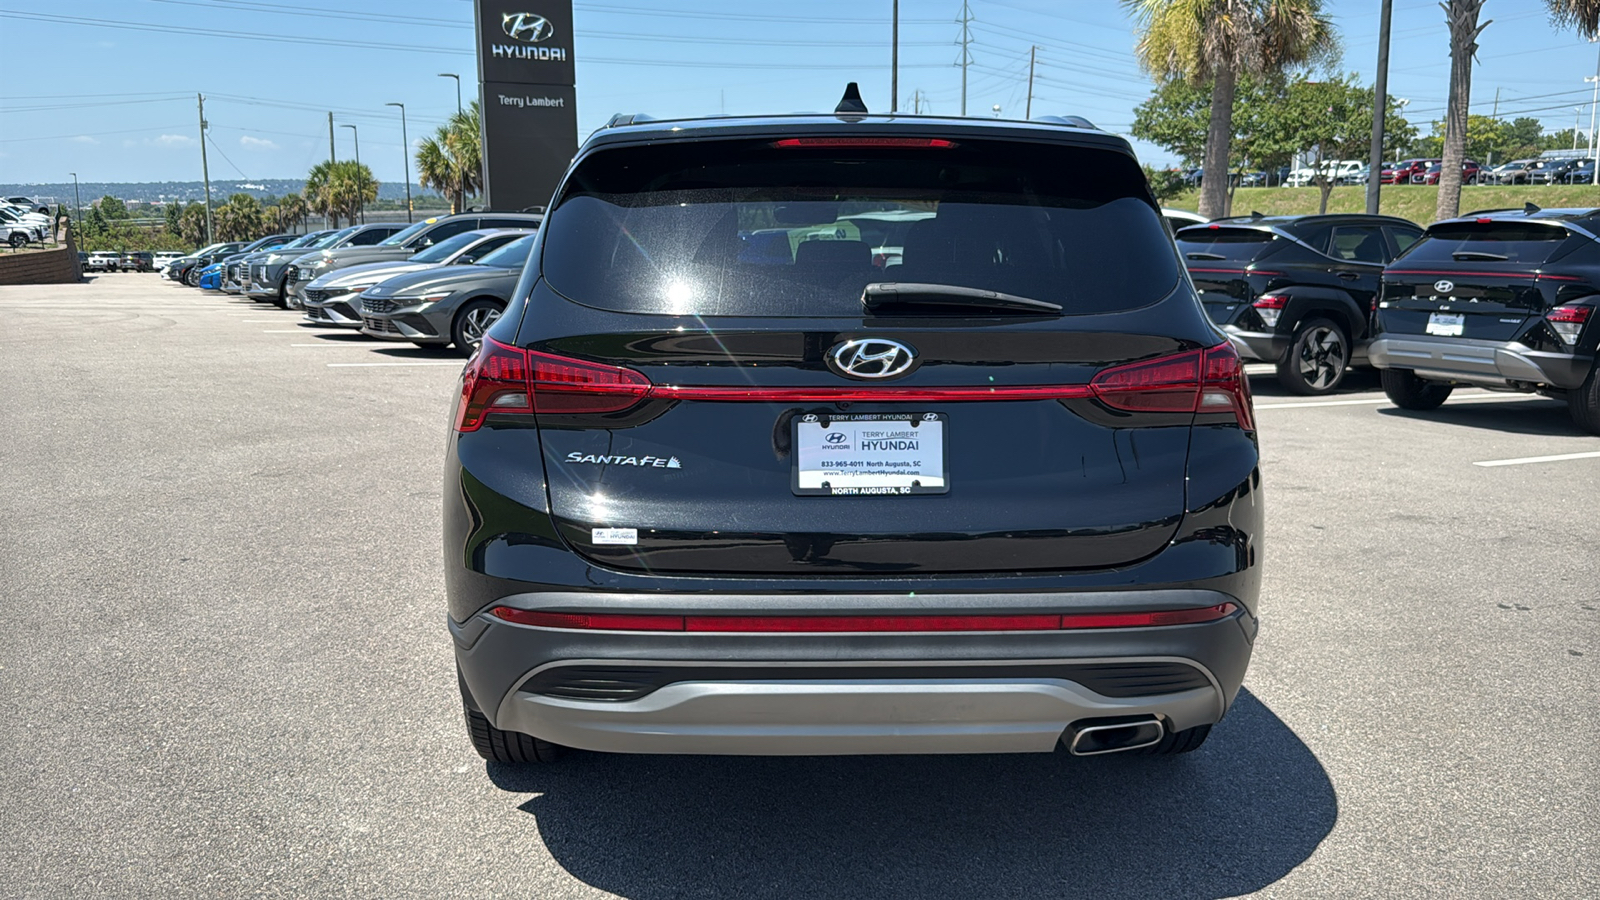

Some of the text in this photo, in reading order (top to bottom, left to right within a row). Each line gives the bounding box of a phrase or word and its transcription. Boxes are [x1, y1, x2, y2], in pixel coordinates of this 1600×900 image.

[492, 44, 566, 61] HYUNDAI
[498, 95, 564, 107] Terry Lambert
[861, 441, 919, 450] HYUNDAI
[885, 461, 912, 469] Augusta,
[860, 487, 899, 495] AUGUSTA,
